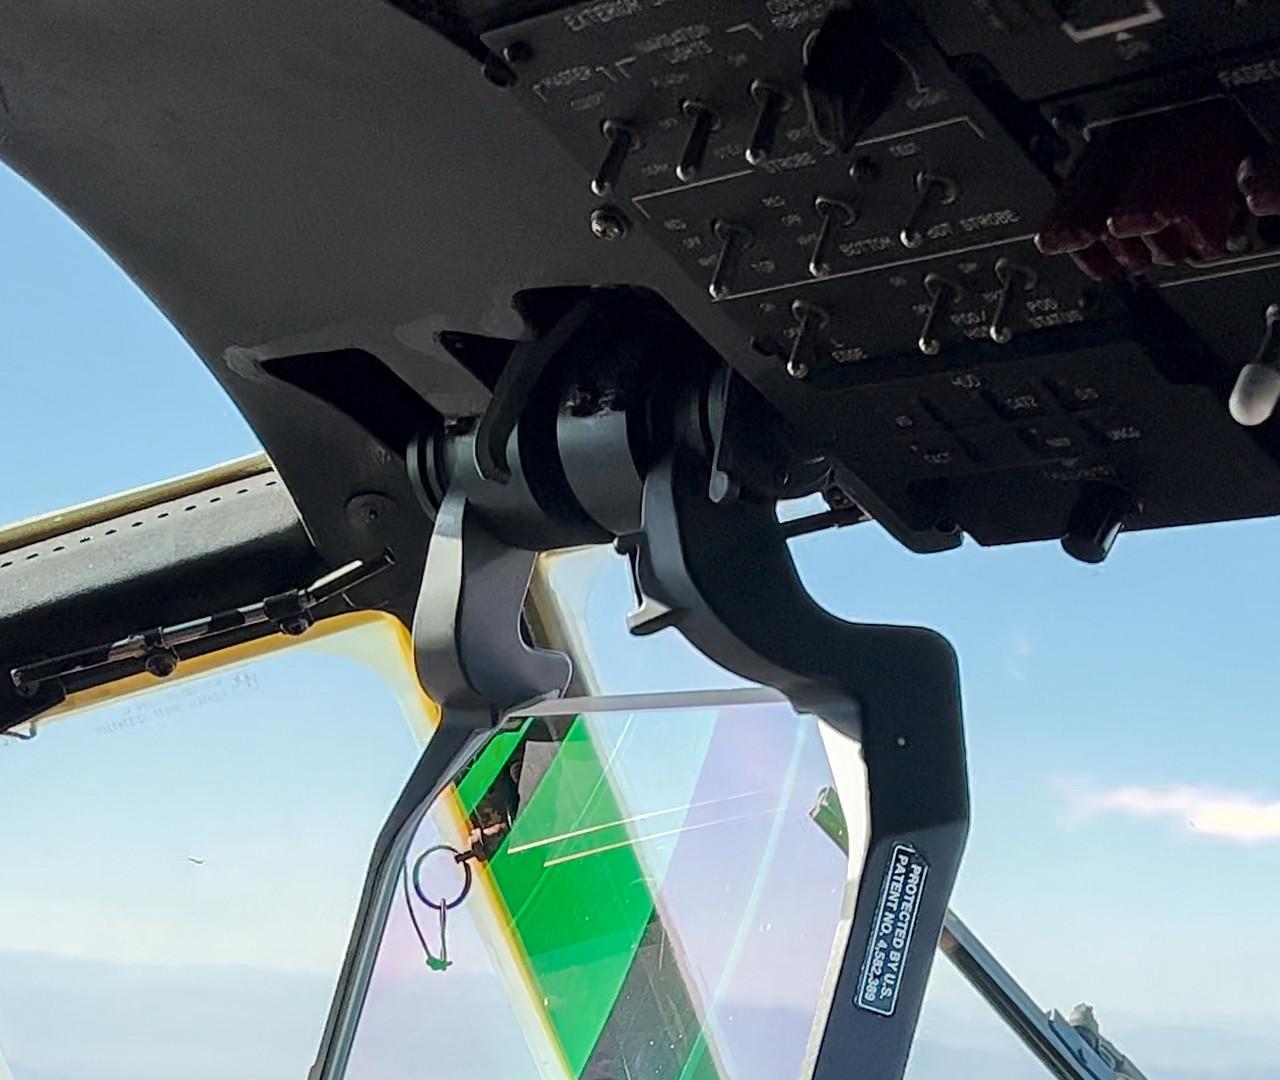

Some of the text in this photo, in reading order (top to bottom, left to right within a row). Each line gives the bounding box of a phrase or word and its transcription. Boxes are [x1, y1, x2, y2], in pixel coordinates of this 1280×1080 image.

[886, 854, 909, 912] PATENT
[879, 914, 894, 937] NO.
[879, 863, 922, 1000] PROTECTED BY U.S.
